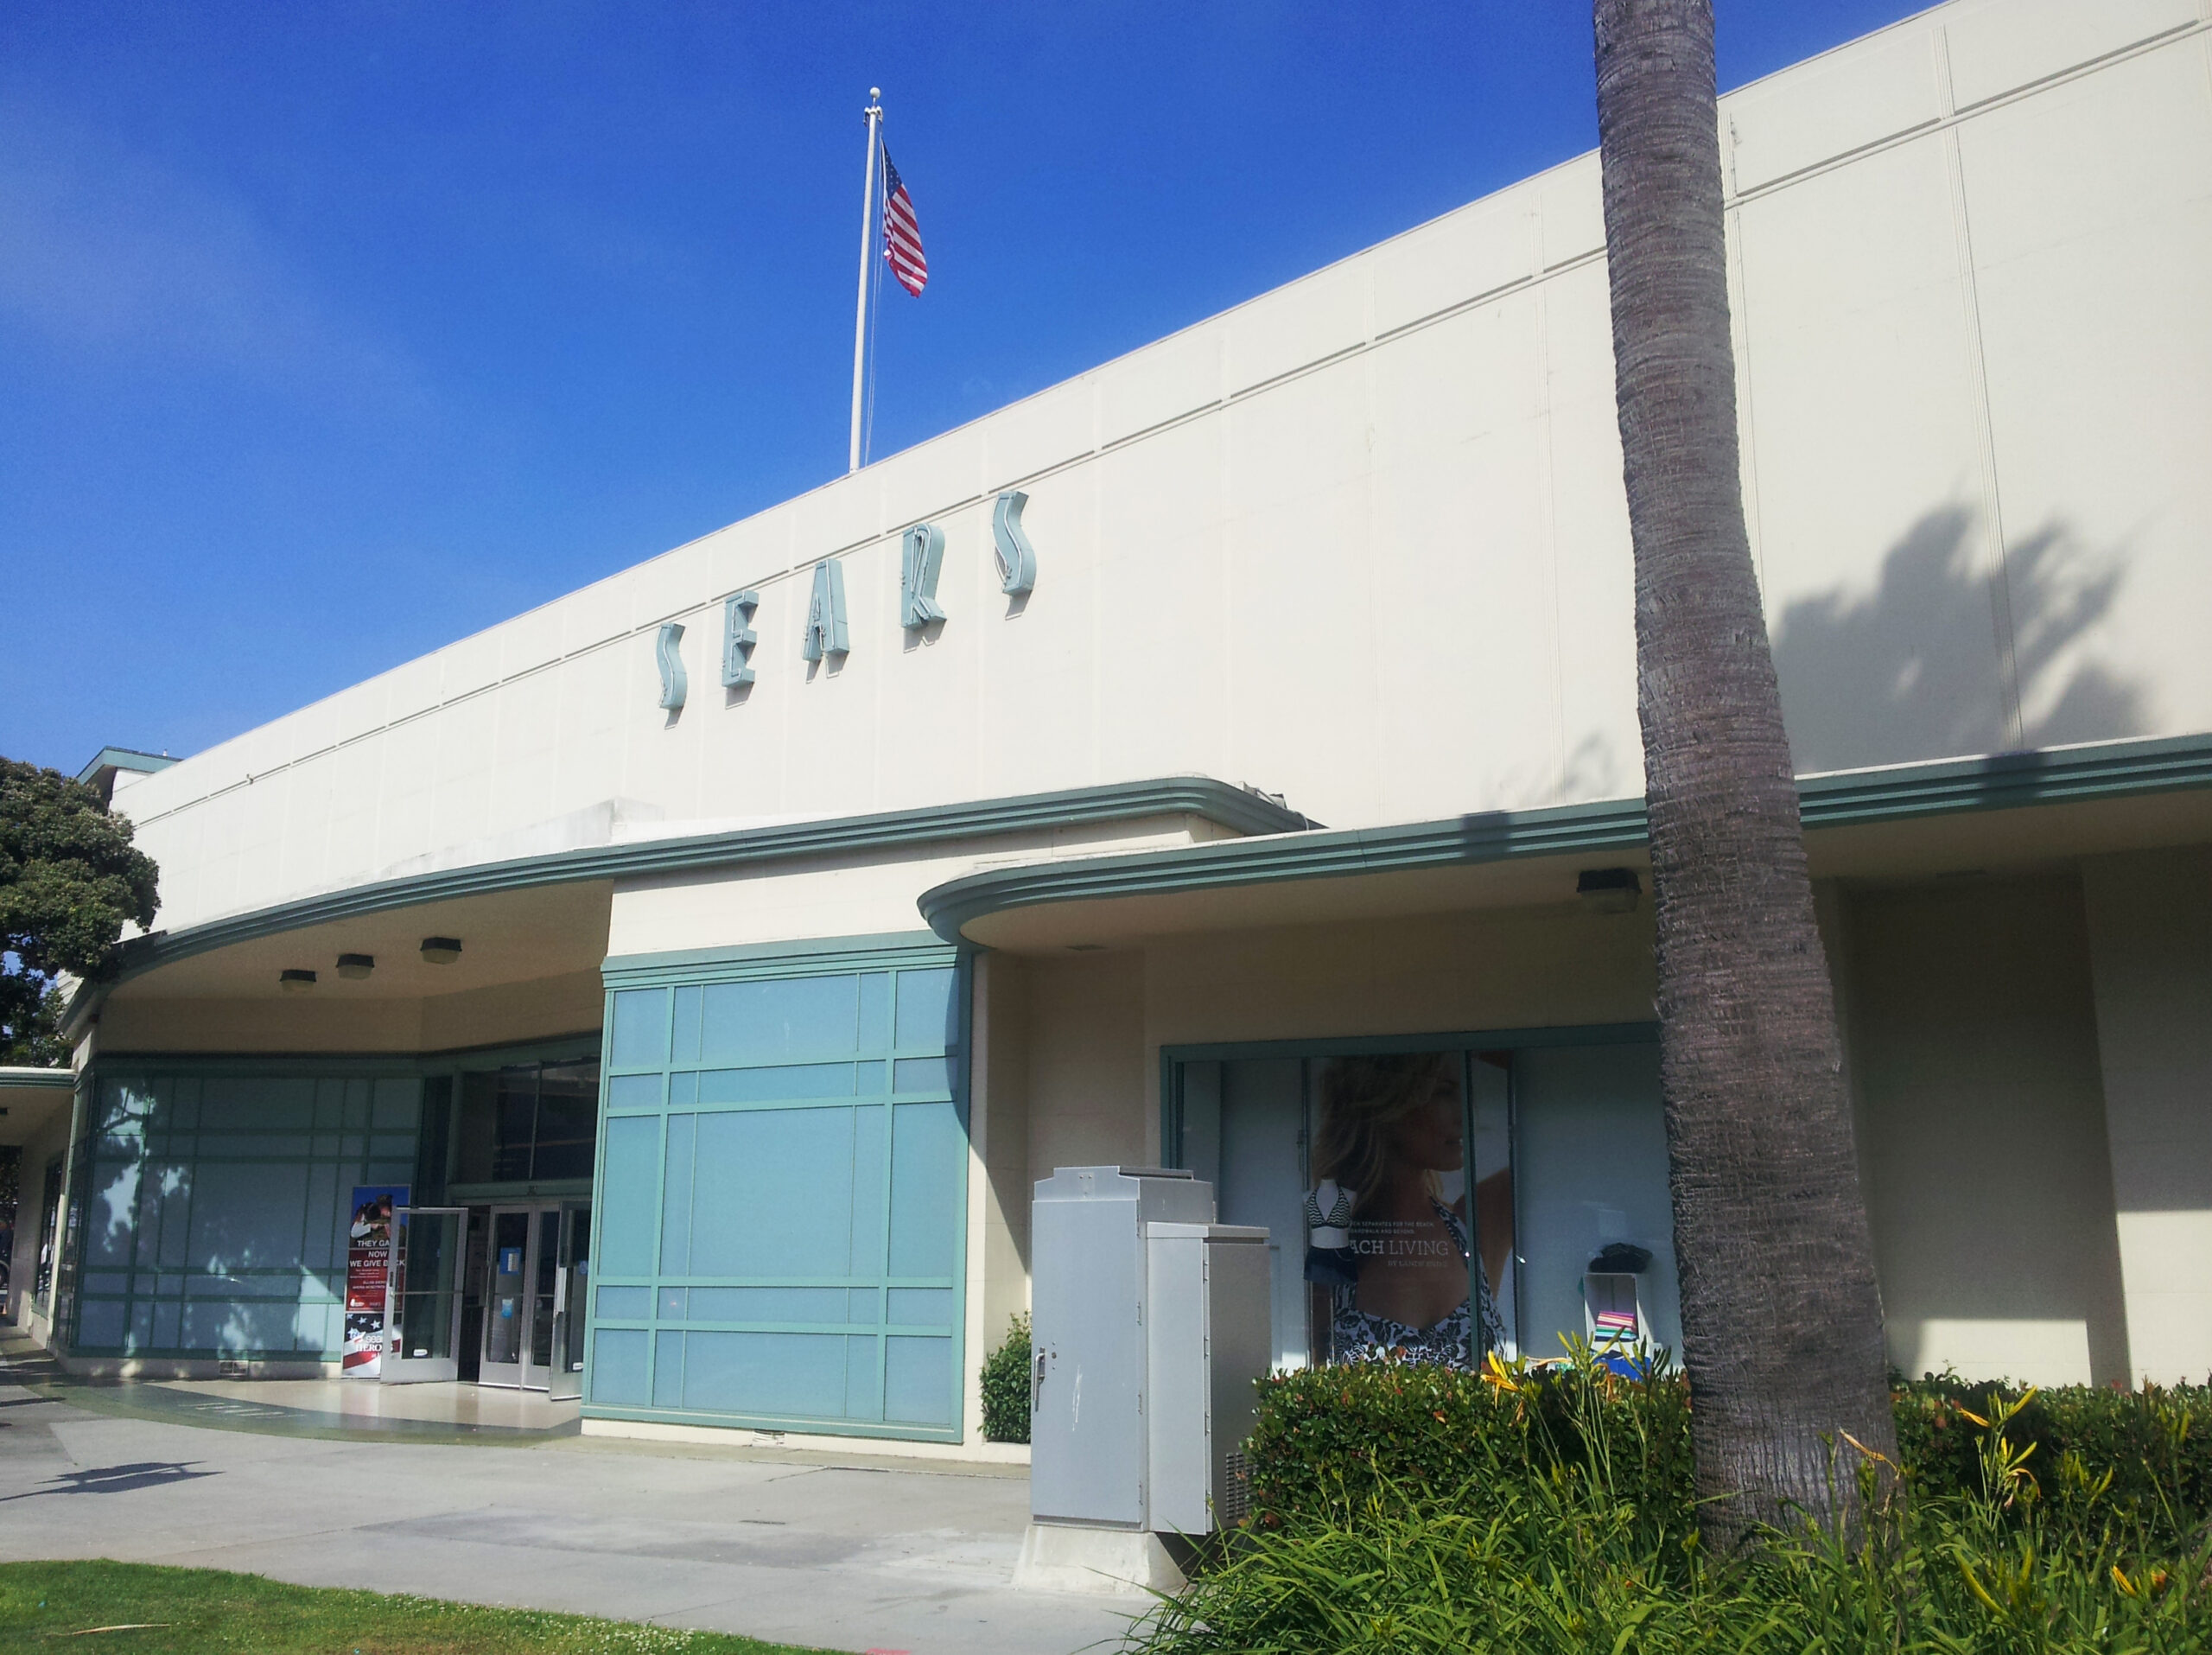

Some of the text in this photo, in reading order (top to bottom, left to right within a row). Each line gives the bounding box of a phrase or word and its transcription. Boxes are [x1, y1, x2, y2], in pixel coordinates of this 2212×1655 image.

[656, 491, 1037, 710] SEARS
[1350, 1239, 1449, 1256] ACH LIVING
